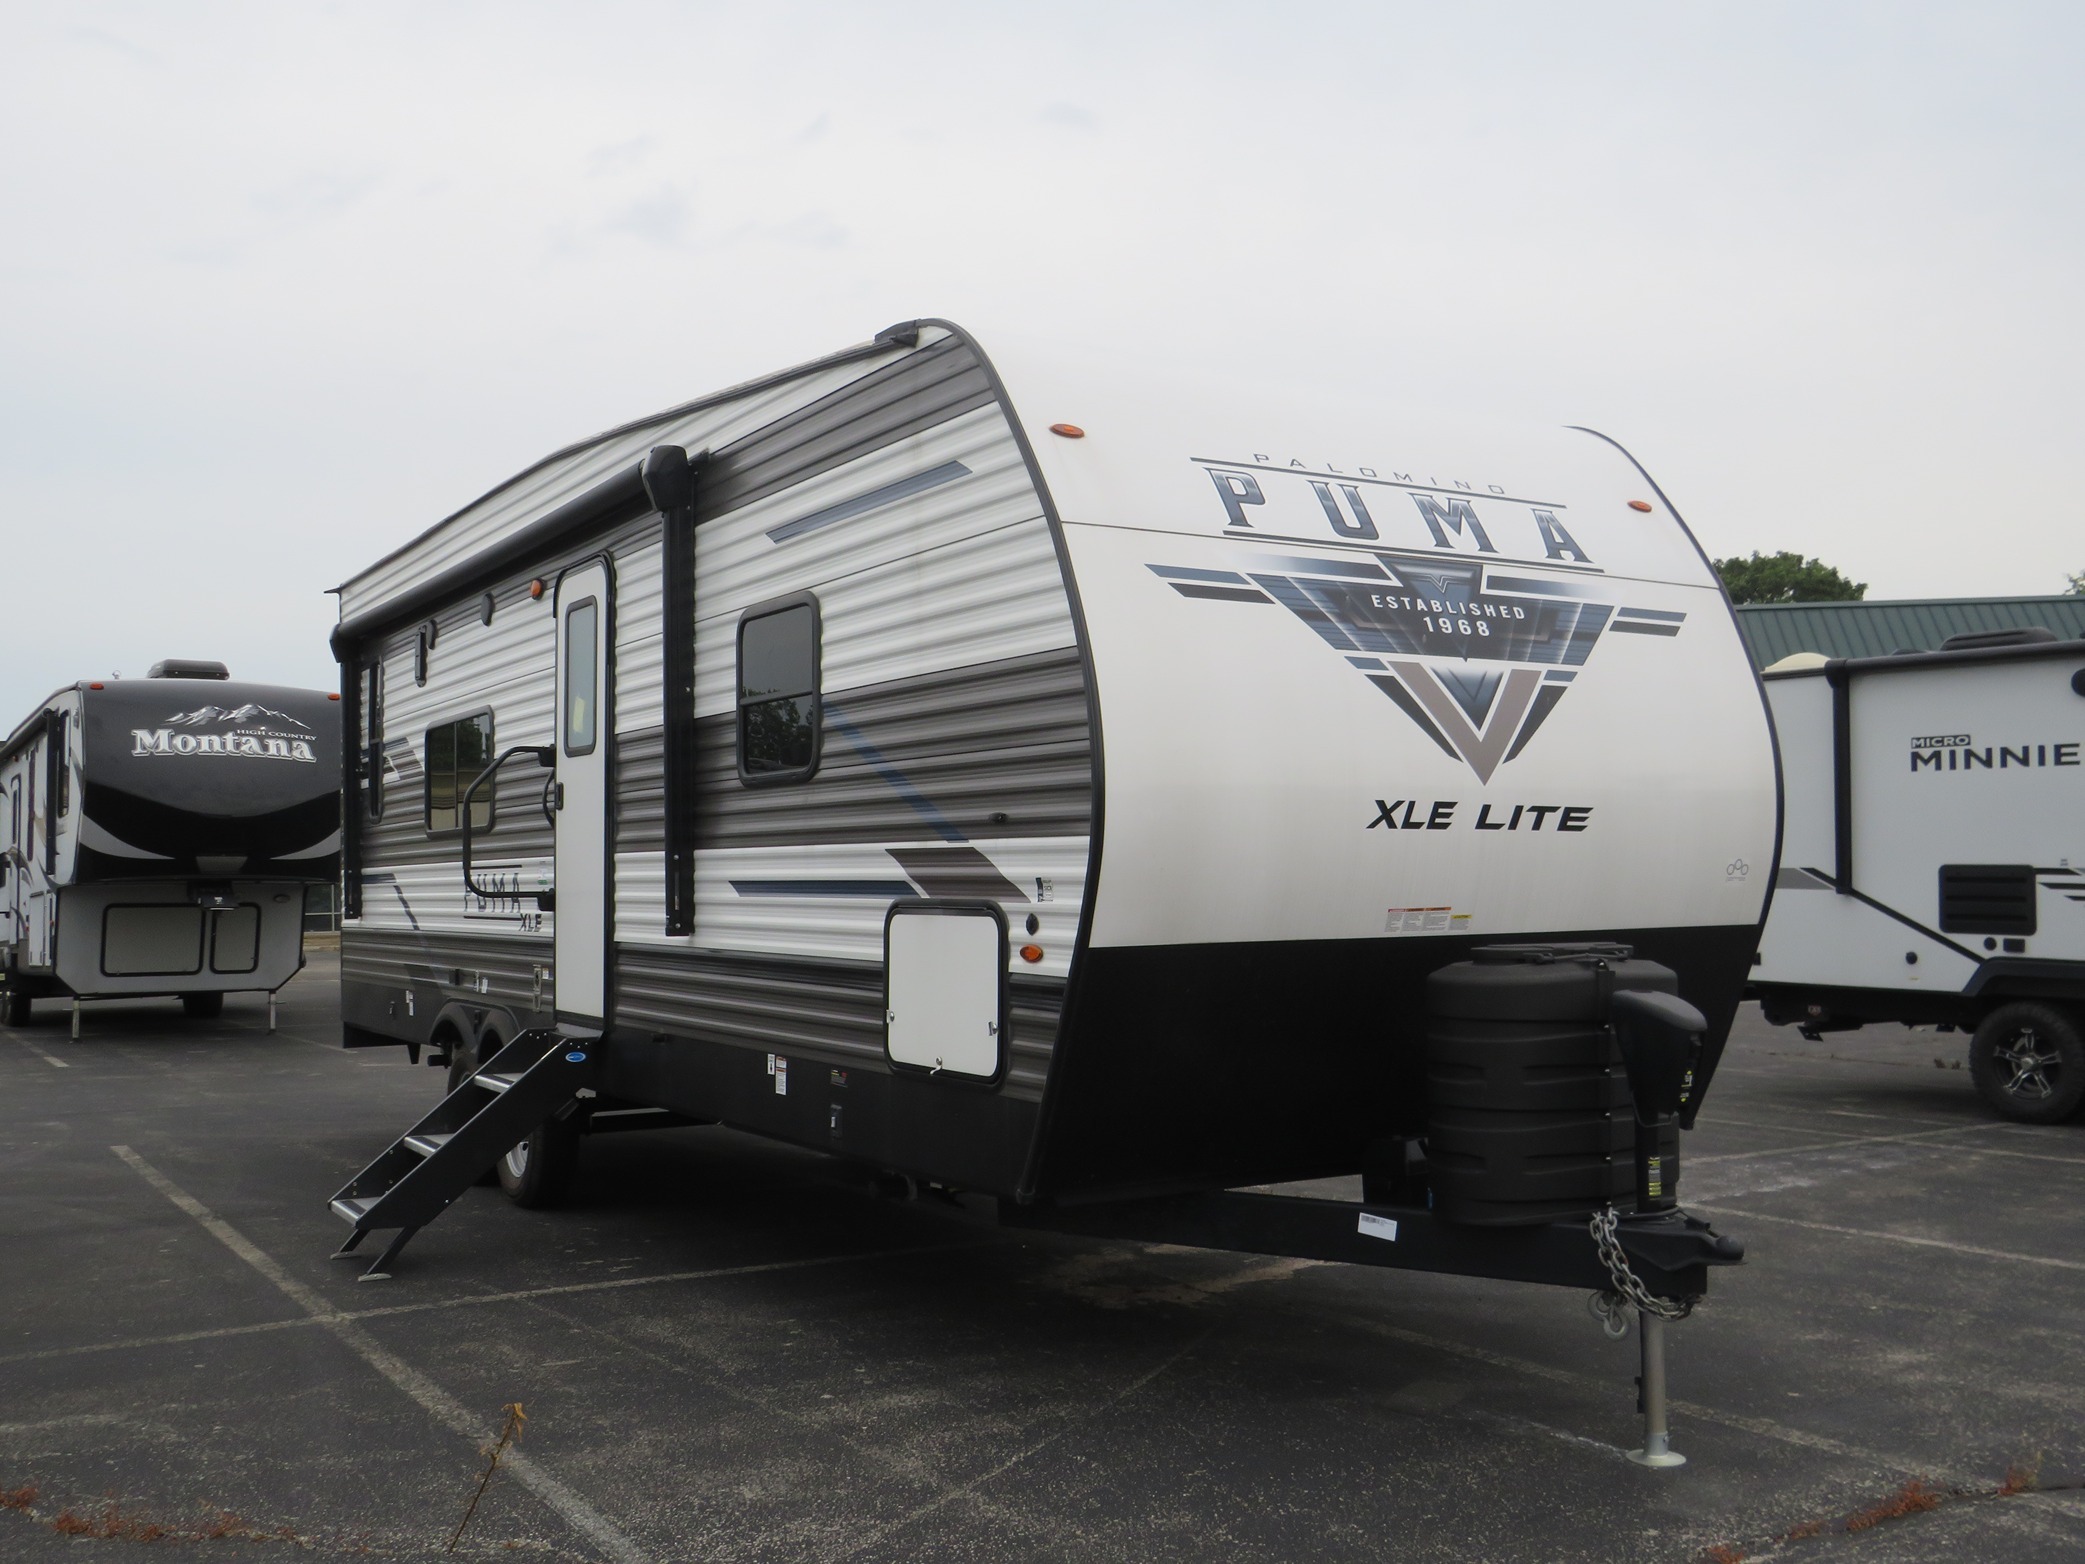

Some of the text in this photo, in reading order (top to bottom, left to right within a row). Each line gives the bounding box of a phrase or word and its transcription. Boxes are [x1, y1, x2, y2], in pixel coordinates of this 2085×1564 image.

[1253, 453, 1506, 495] PALOMINO
[1202, 466, 1595, 564] PUMA
[1371, 594, 1526, 620] ESTABLISHED
[1423, 616, 1490, 637] 1968
[131, 728, 317, 763] Montana
[236, 728, 317, 742] HIGH COUNTRY
[1911, 735, 1970, 748] MICRO
[1911, 743, 2081, 772] MINNIE
[1366, 799, 1594, 832] XLE LITE
[518, 913, 543, 933] XLE
